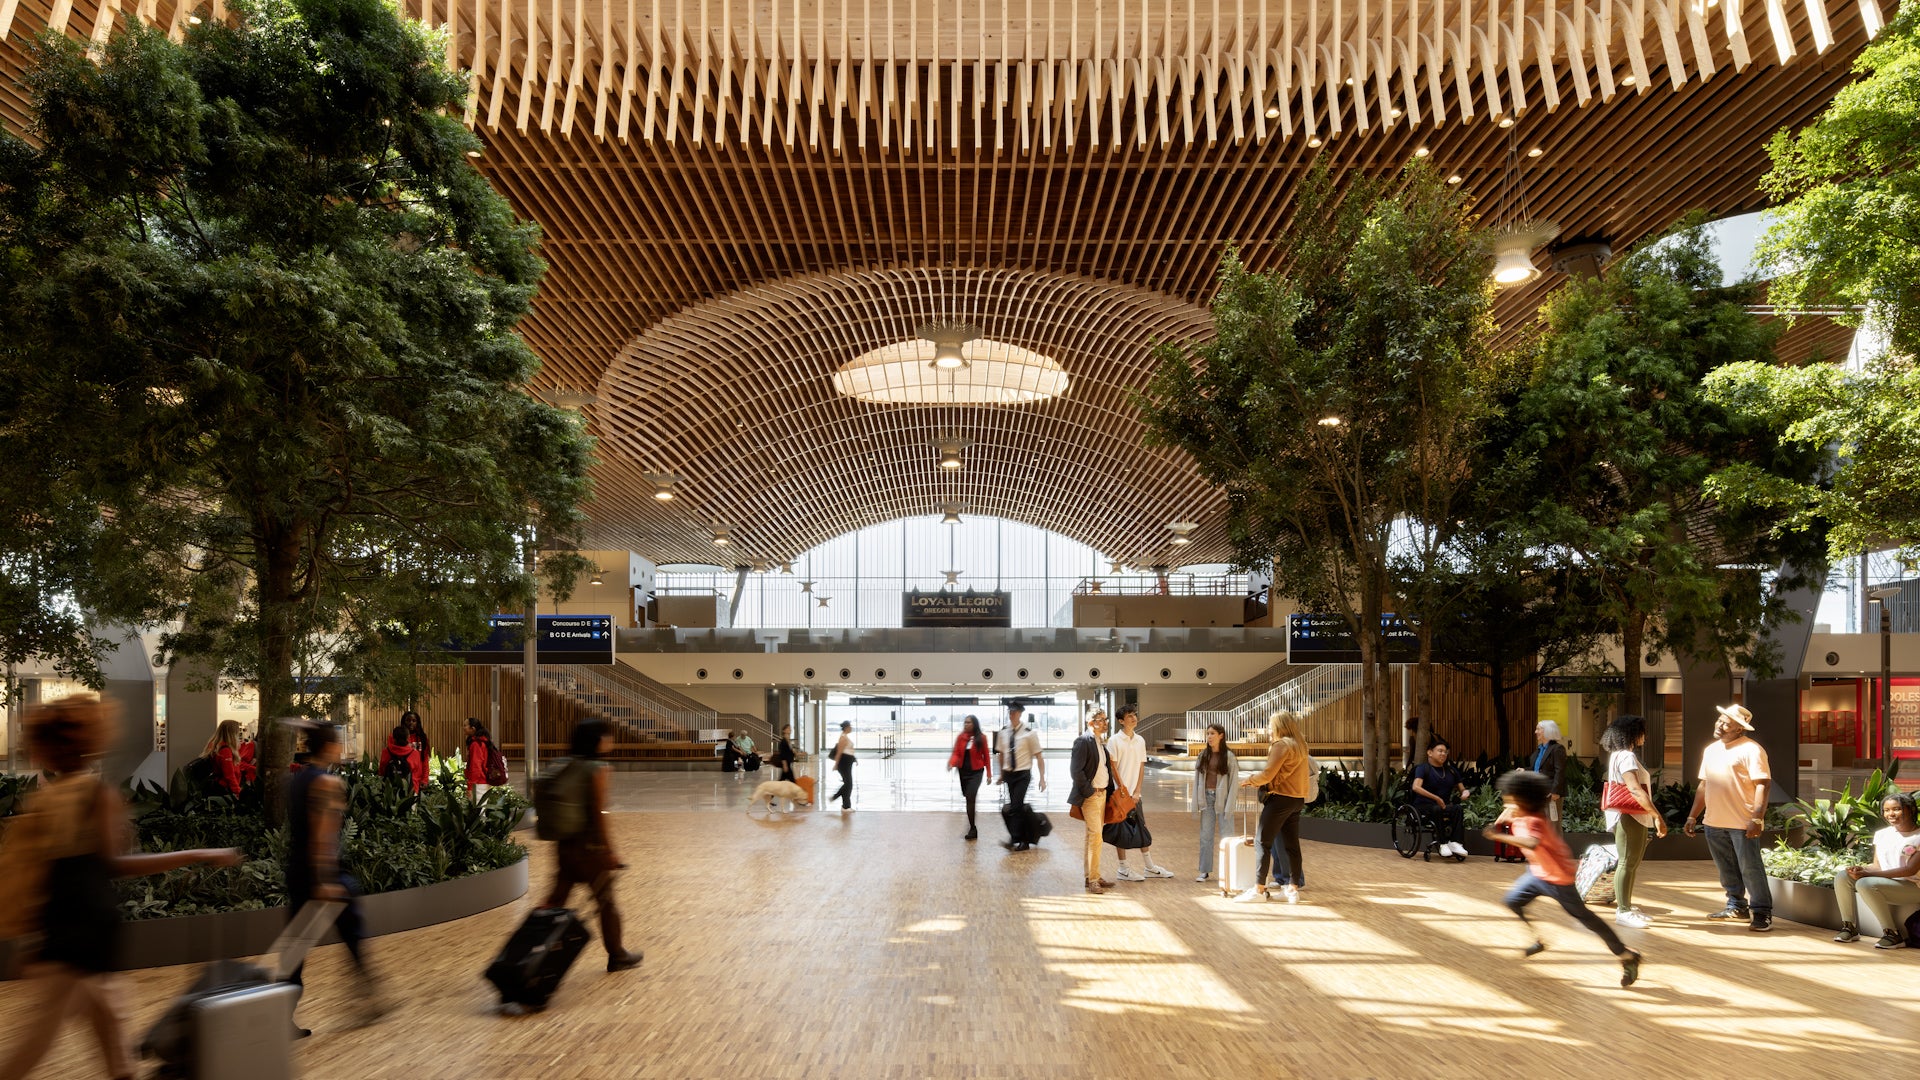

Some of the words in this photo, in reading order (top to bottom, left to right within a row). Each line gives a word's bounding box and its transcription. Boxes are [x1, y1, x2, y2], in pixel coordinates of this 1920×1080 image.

[911, 595, 955, 606] LOYAL
[958, 595, 1003, 606] LEGION
[1890, 703, 1918, 714] CARD
[1899, 726, 1920, 737] THE
